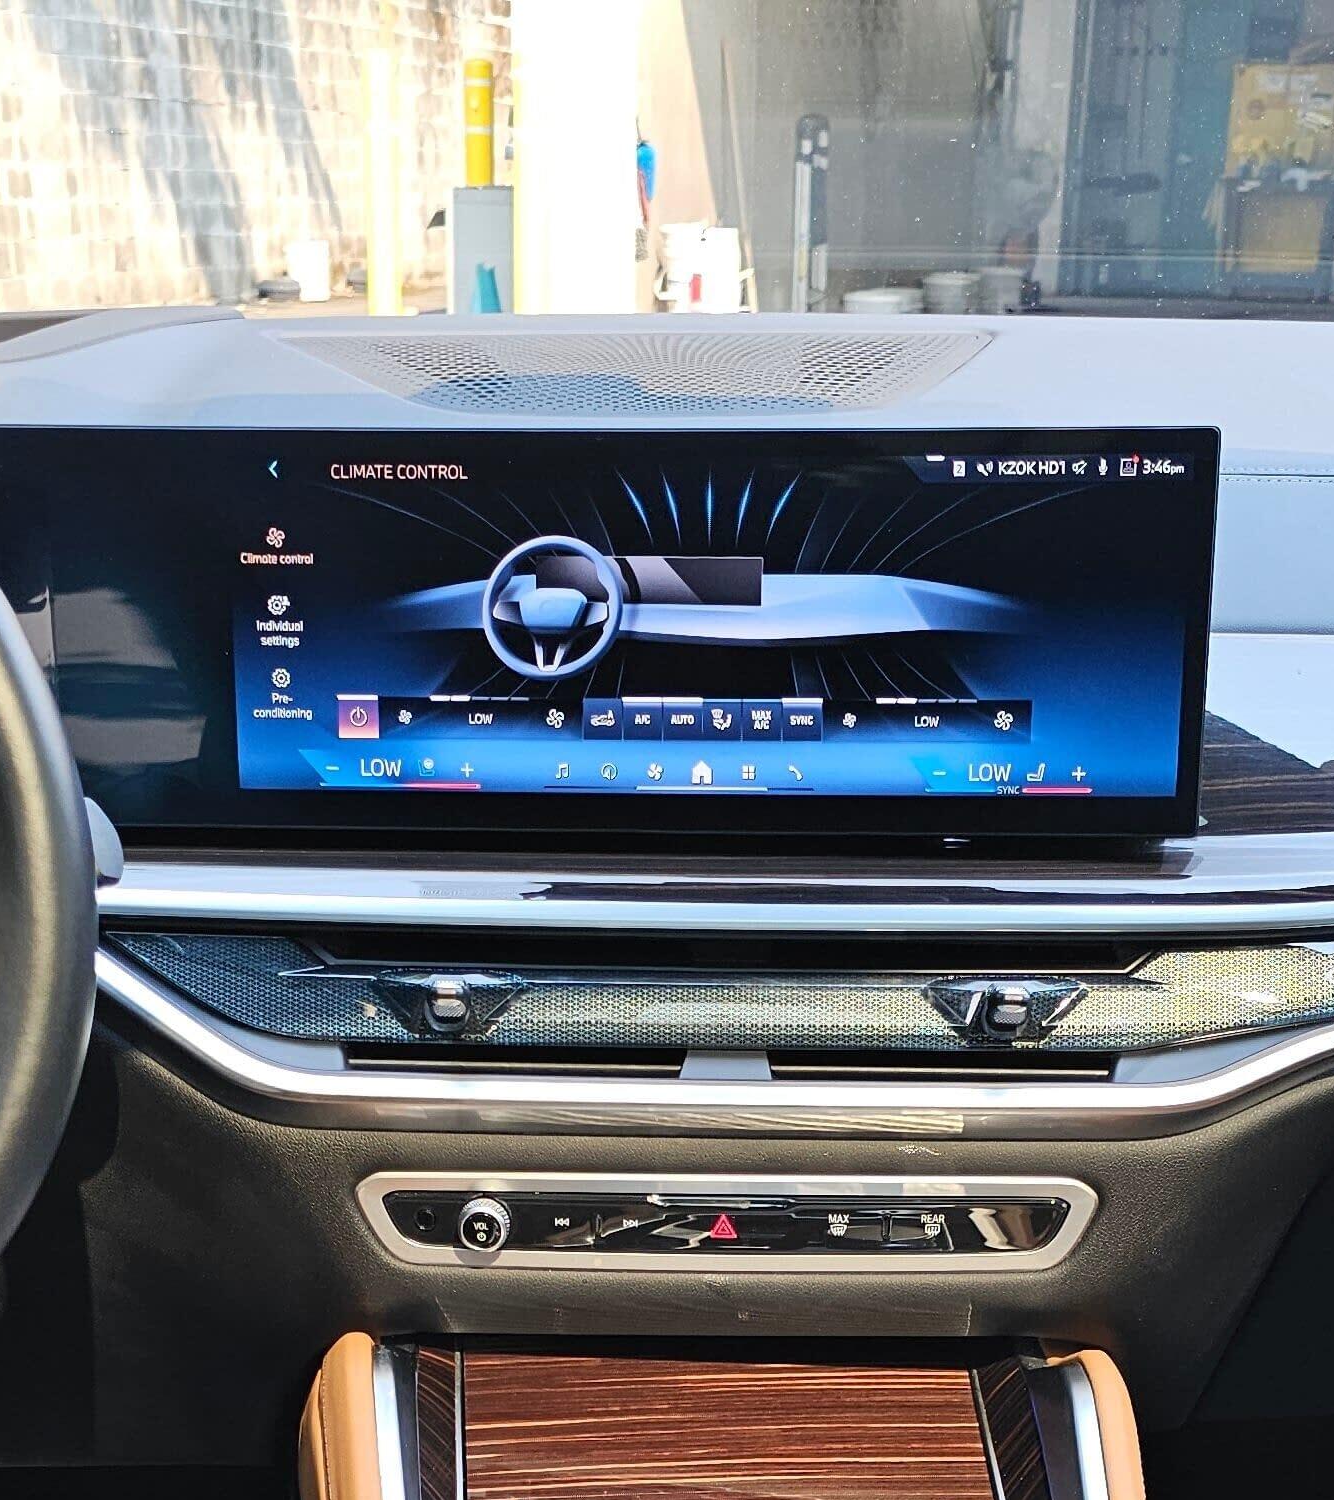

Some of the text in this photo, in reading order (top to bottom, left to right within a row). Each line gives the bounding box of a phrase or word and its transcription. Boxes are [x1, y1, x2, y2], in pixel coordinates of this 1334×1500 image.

[330, 463, 468, 480] CLIMATE CONTROL
[1142, 459, 1185, 474] 3:46pm
[240, 553, 314, 565] Climate control
[256, 620, 304, 632] Individual
[260, 635, 300, 648] settings
[271, 693, 294, 705] Pre-
[253, 707, 313, 721] conditioning
[468, 713, 494, 725] LOW
[634, 714, 651, 725] A/C
[671, 714, 695, 726] AUTO
[752, 710, 772, 720] MAX
[753, 720, 770, 730] A/C
[789, 715, 814, 726] SYNC
[914, 716, 940, 728] LOW
[360, 758, 402, 777] LOW
[968, 764, 1012, 782] LOW
[996, 786, 1020, 795] SYNC
[828, 1214, 850, 1224] MAX
[920, 1214, 945, 1224] REAR
[473, 1222, 489, 1231] VOL
